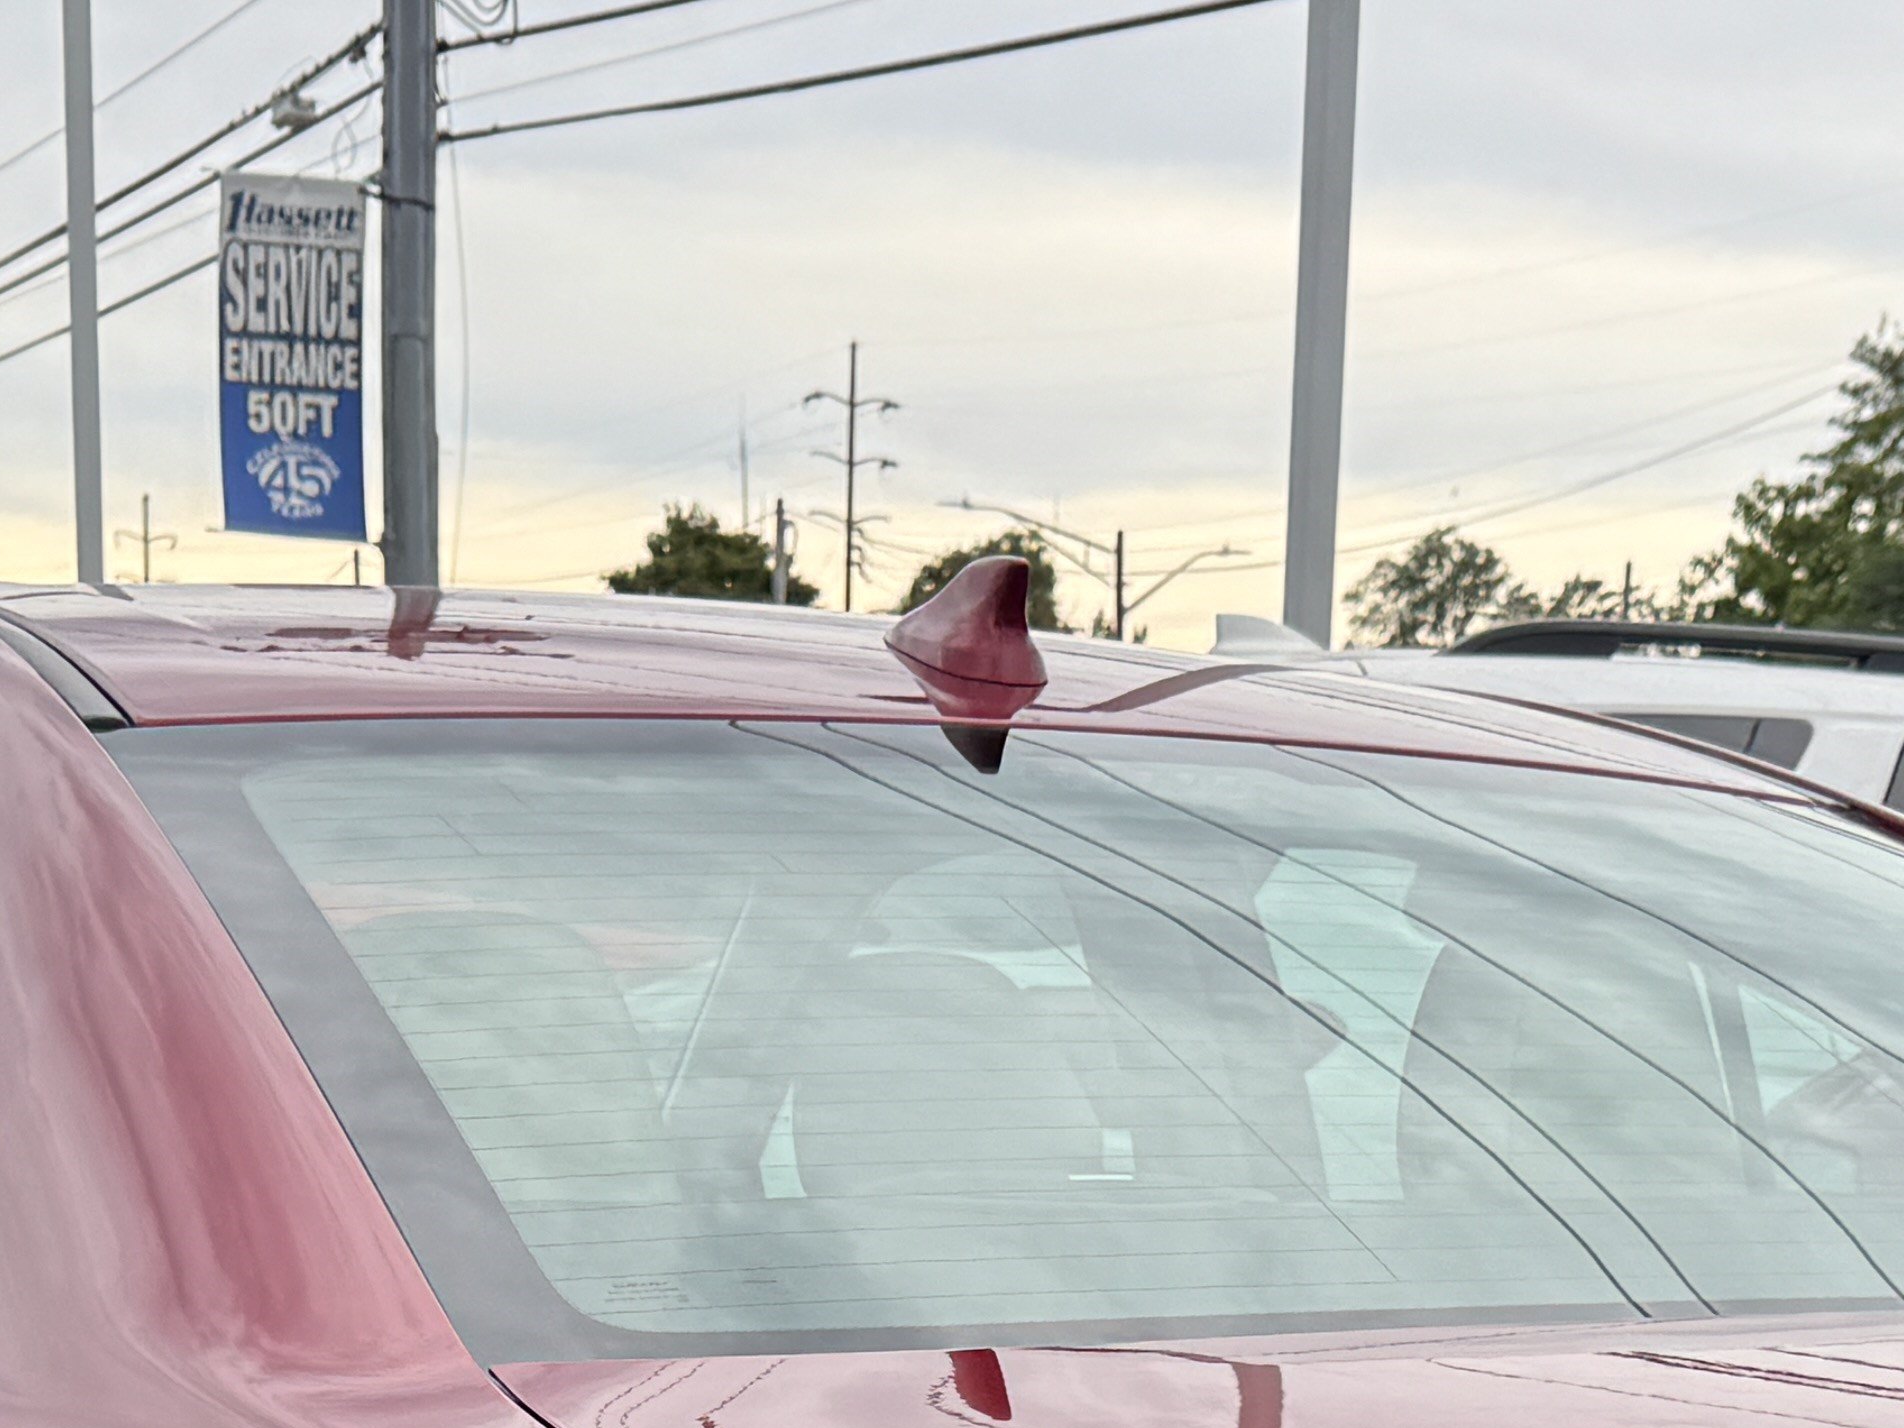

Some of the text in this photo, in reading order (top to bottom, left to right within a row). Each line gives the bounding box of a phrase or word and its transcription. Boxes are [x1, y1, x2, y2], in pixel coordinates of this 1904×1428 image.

[226, 188, 359, 233] Hassett
[224, 241, 360, 341] SERVICE
[223, 337, 360, 391] ENTRANCE
